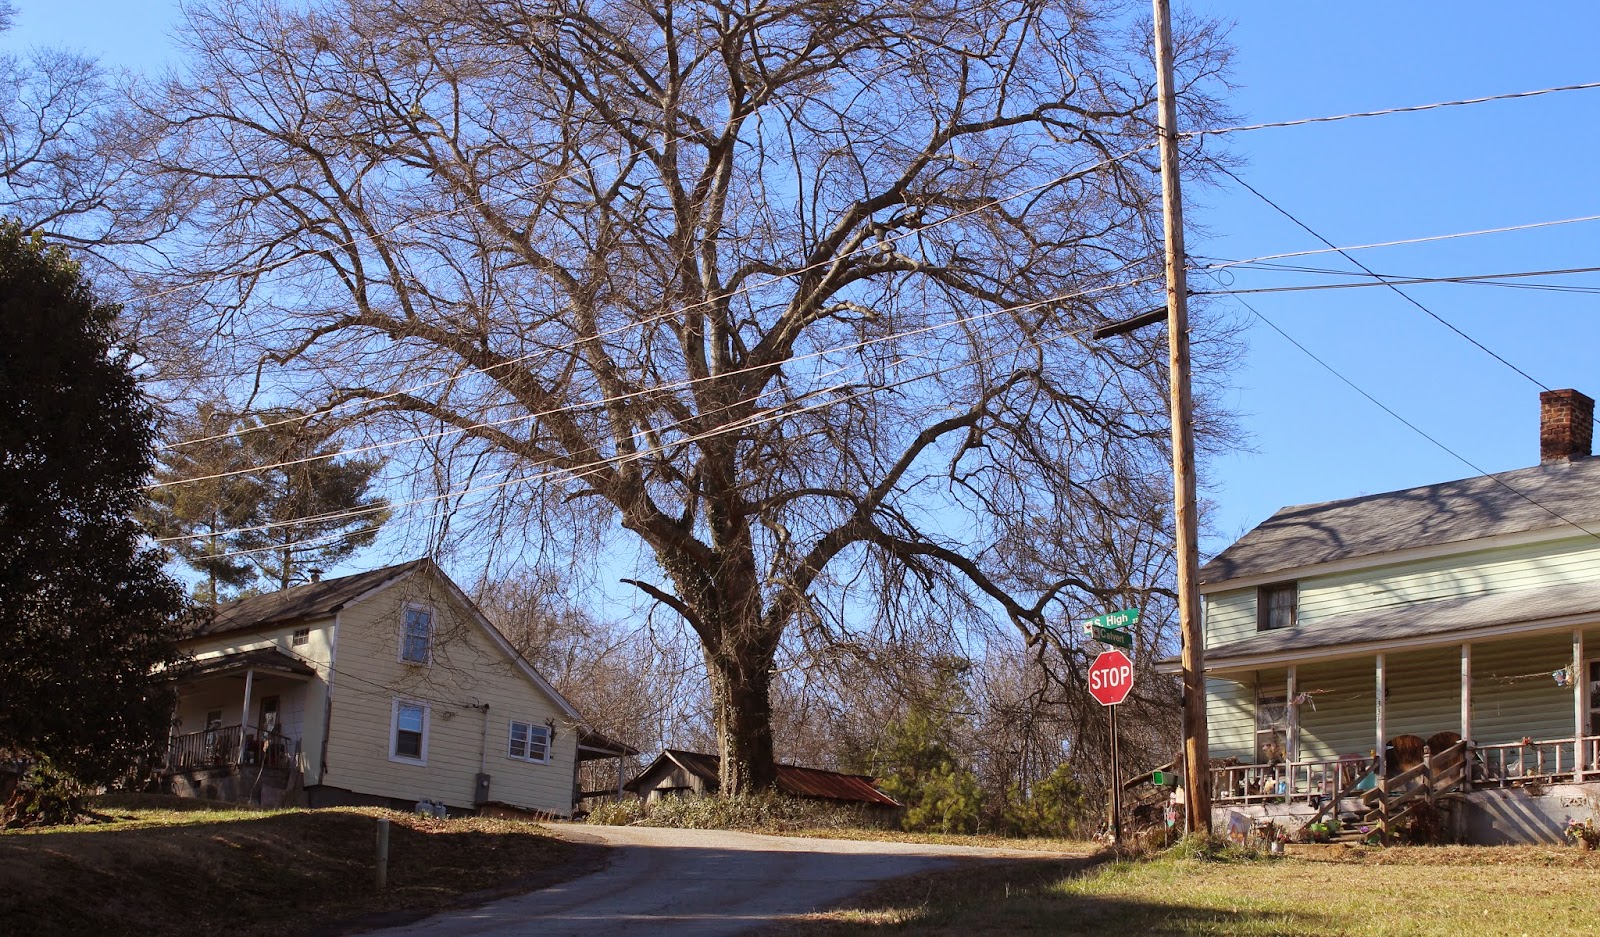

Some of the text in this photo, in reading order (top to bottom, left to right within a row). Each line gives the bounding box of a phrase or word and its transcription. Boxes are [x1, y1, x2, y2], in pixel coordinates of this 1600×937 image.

[1106, 613, 1128, 627] High
[1100, 628, 1125, 644] Calvert
[1091, 665, 1130, 690] STOP
